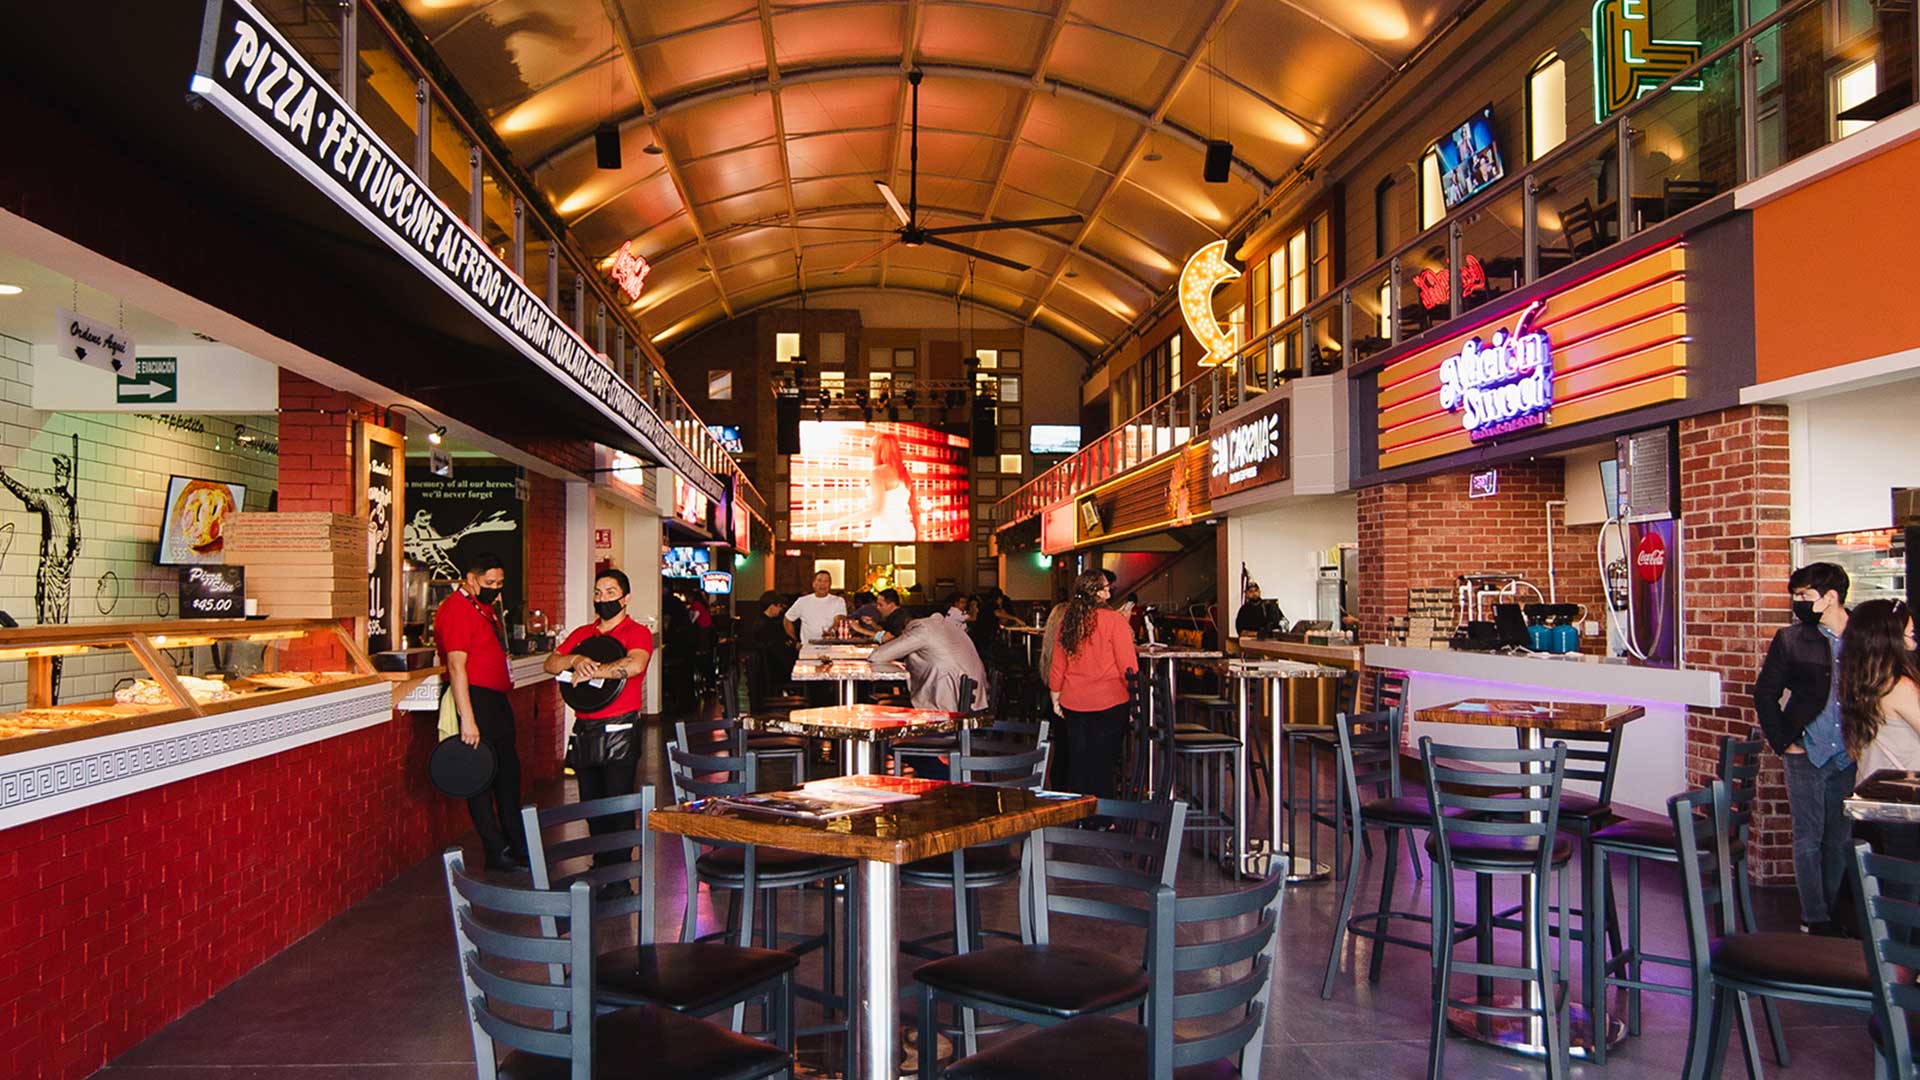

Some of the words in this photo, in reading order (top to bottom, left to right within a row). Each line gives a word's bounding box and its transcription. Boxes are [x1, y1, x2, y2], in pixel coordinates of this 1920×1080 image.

[225, 20, 318, 146] PIZZA
[319, 108, 444, 253] FETTUCCINE
[436, 223, 502, 307] ALFREDO
[500, 282, 551, 351] LASAGNA
[548, 326, 589, 383] INSALATA
[70, 321, 101, 345] Ordene
[411, 481, 445, 489] memory
[447, 480, 456, 488] of
[457, 480, 468, 488] all
[468, 490, 493, 499] forget
[189, 567, 223, 586] Pizza
[193, 599, 233, 611] $45.00
